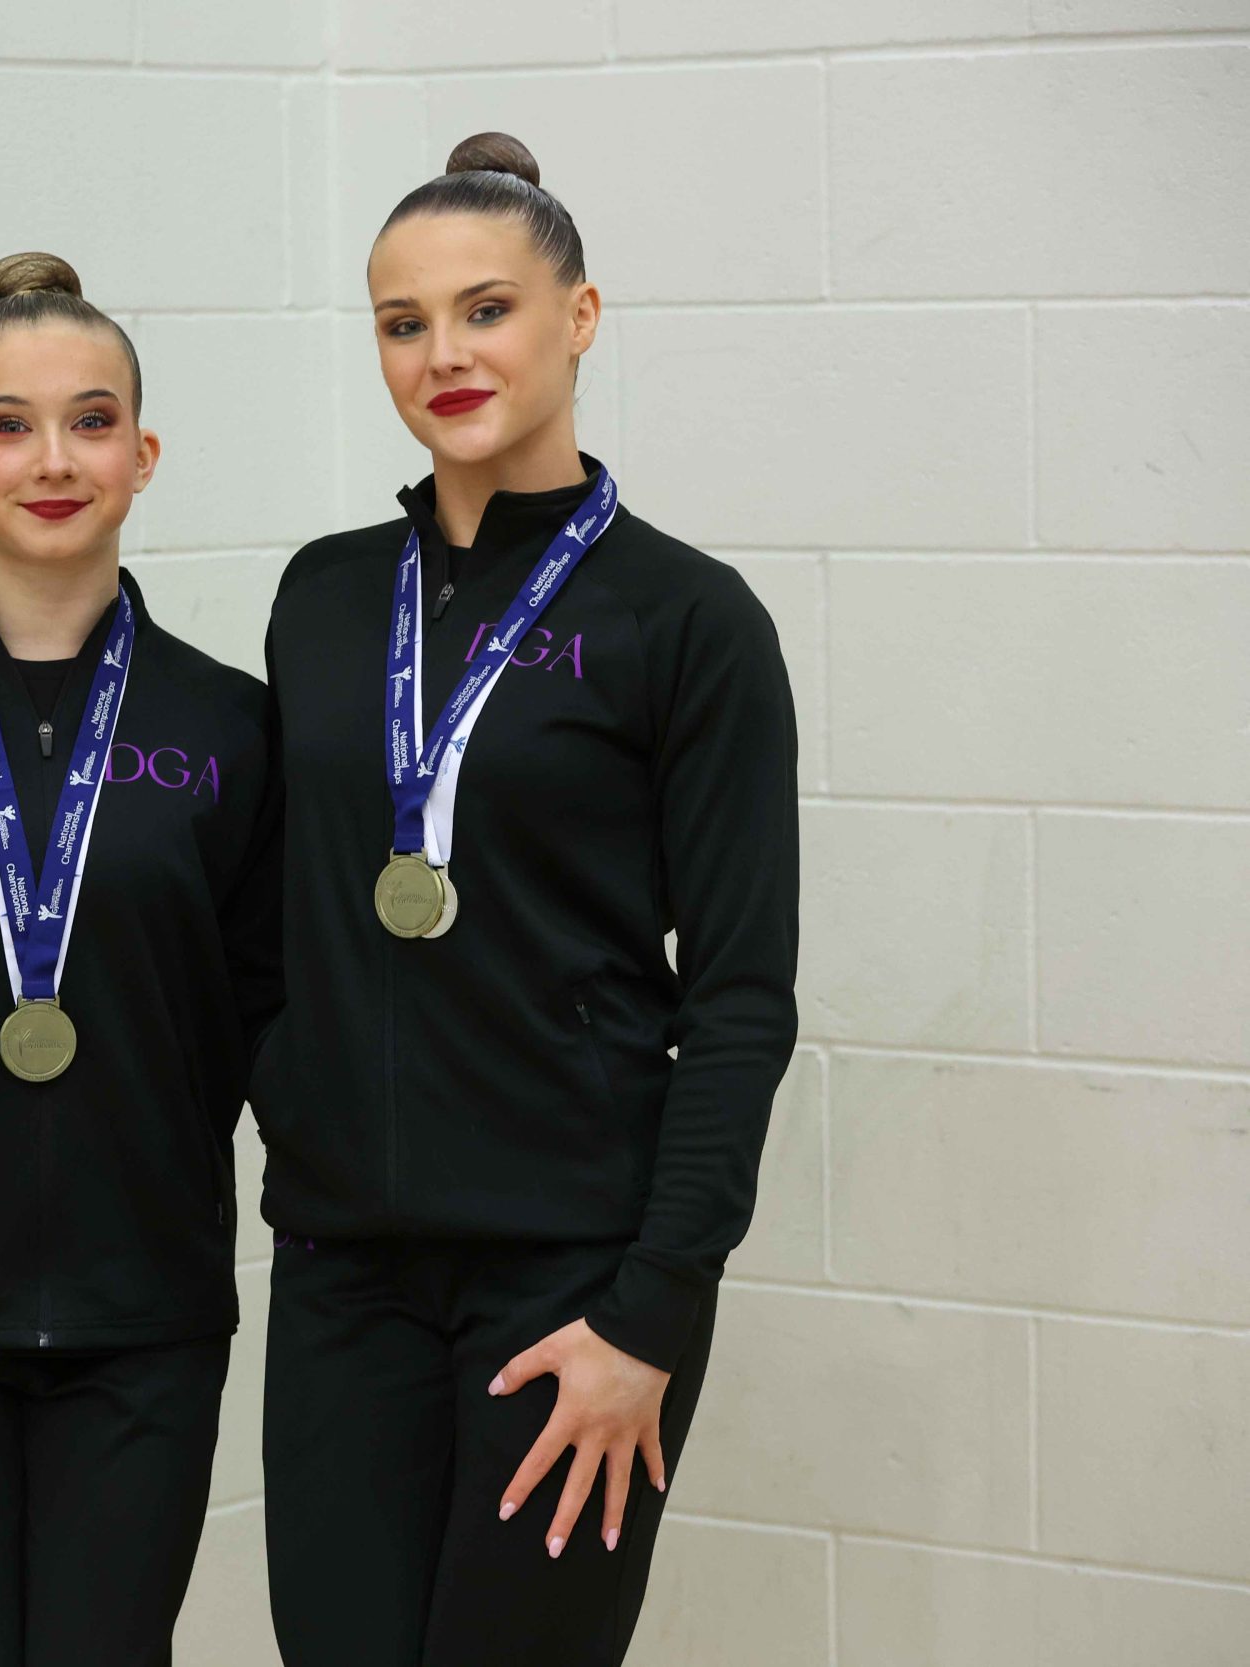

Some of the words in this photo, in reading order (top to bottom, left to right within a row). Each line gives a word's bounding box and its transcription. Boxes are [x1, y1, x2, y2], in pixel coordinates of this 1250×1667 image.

[529, 552, 571, 607] Championships
[530, 558, 558, 593] National
[90, 689, 106, 725] National
[94, 681, 116, 740] Championships
[448, 665, 492, 724] Championships
[451, 675, 478, 709] National
[104, 743, 220, 804] DGA
[392, 719, 402, 785] Championships
[400, 731, 410, 769] National
[56, 812, 74, 849] National
[60, 801, 85, 865] Championships
[6, 863, 25, 932] Championships
[16, 877, 32, 916] National
